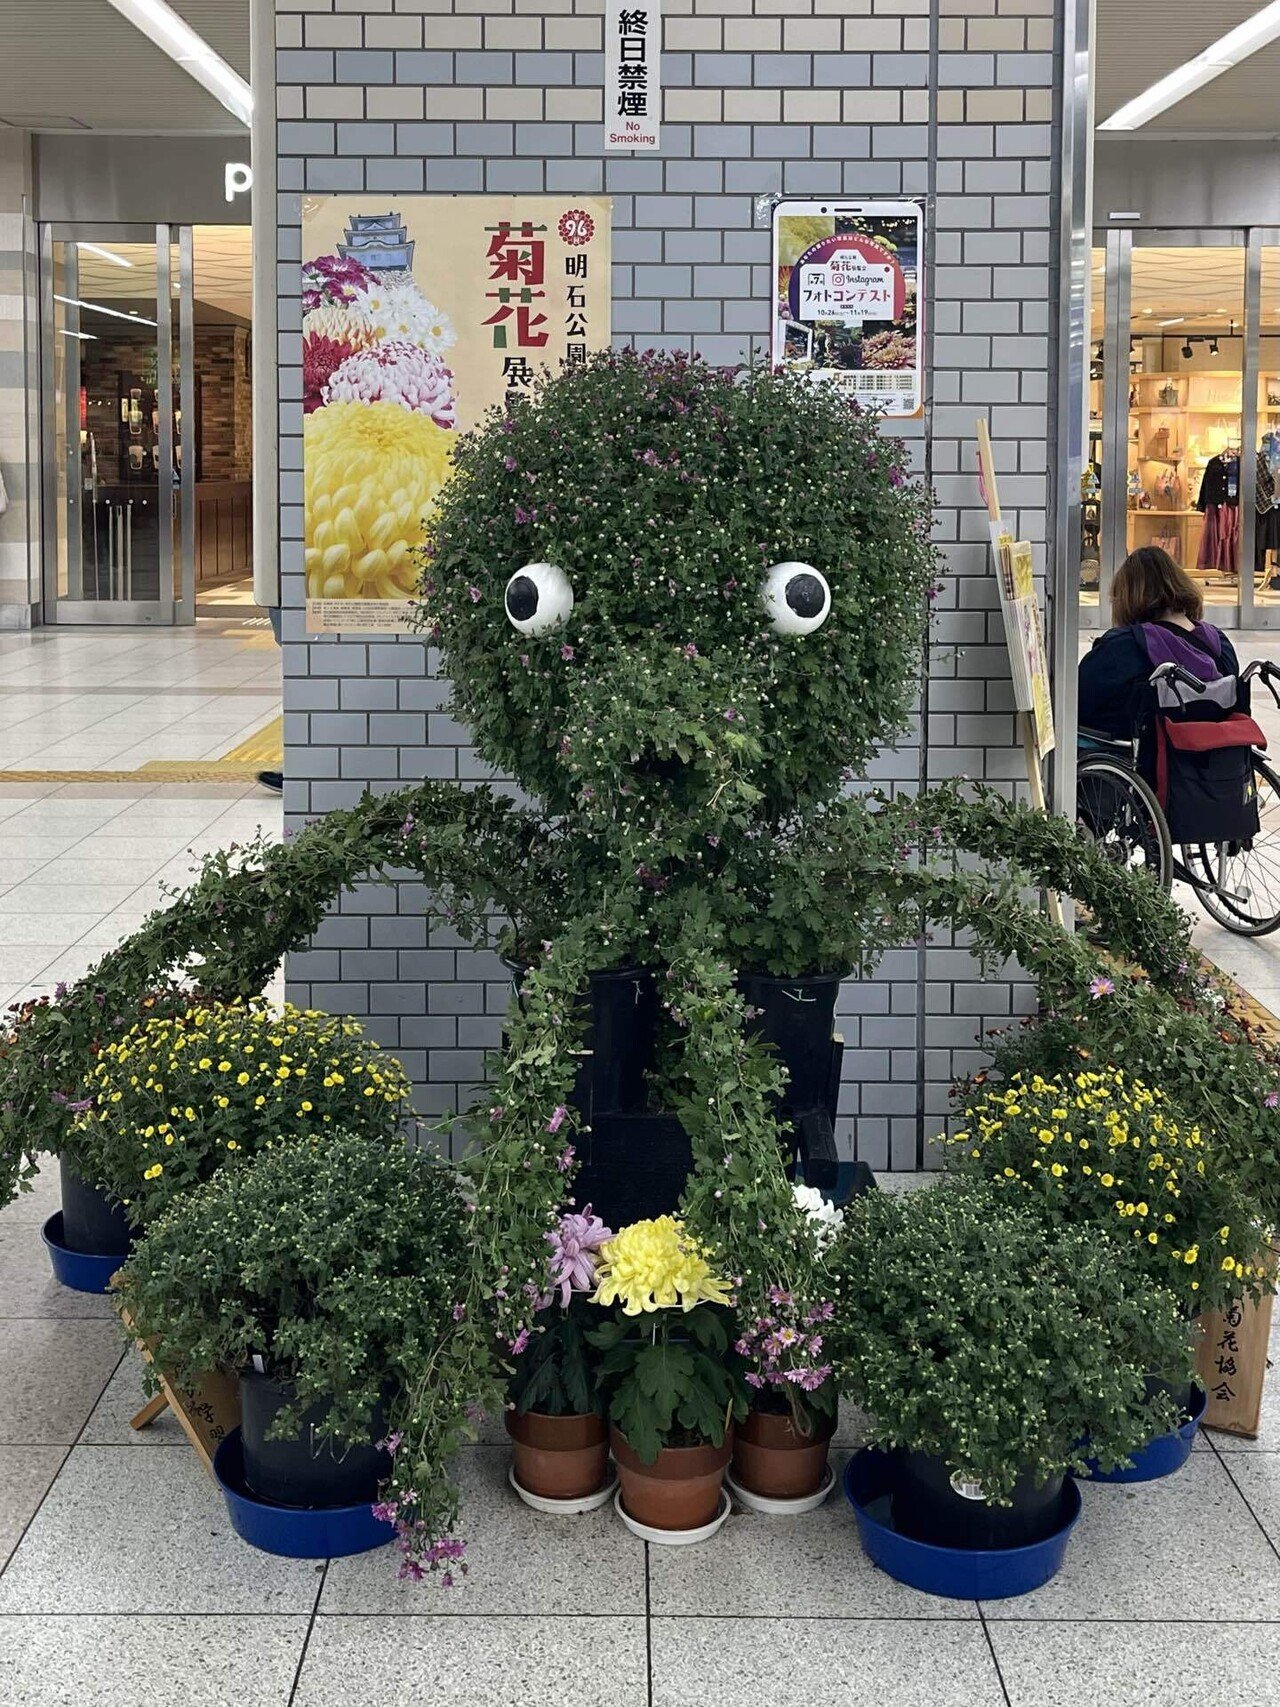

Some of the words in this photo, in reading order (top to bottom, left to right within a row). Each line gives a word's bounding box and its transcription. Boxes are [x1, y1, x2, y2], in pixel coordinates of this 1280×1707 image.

[618, 9, 648, 116] 終日禁煙
[626, 122, 640, 131] No
[610, 134, 655, 144] Smoking
[565, 220, 587, 236] 96
[846, 275, 884, 286] Instagram
[803, 289, 891, 302] フォトコンテスト
[565, 254, 588, 366] 明石公園
